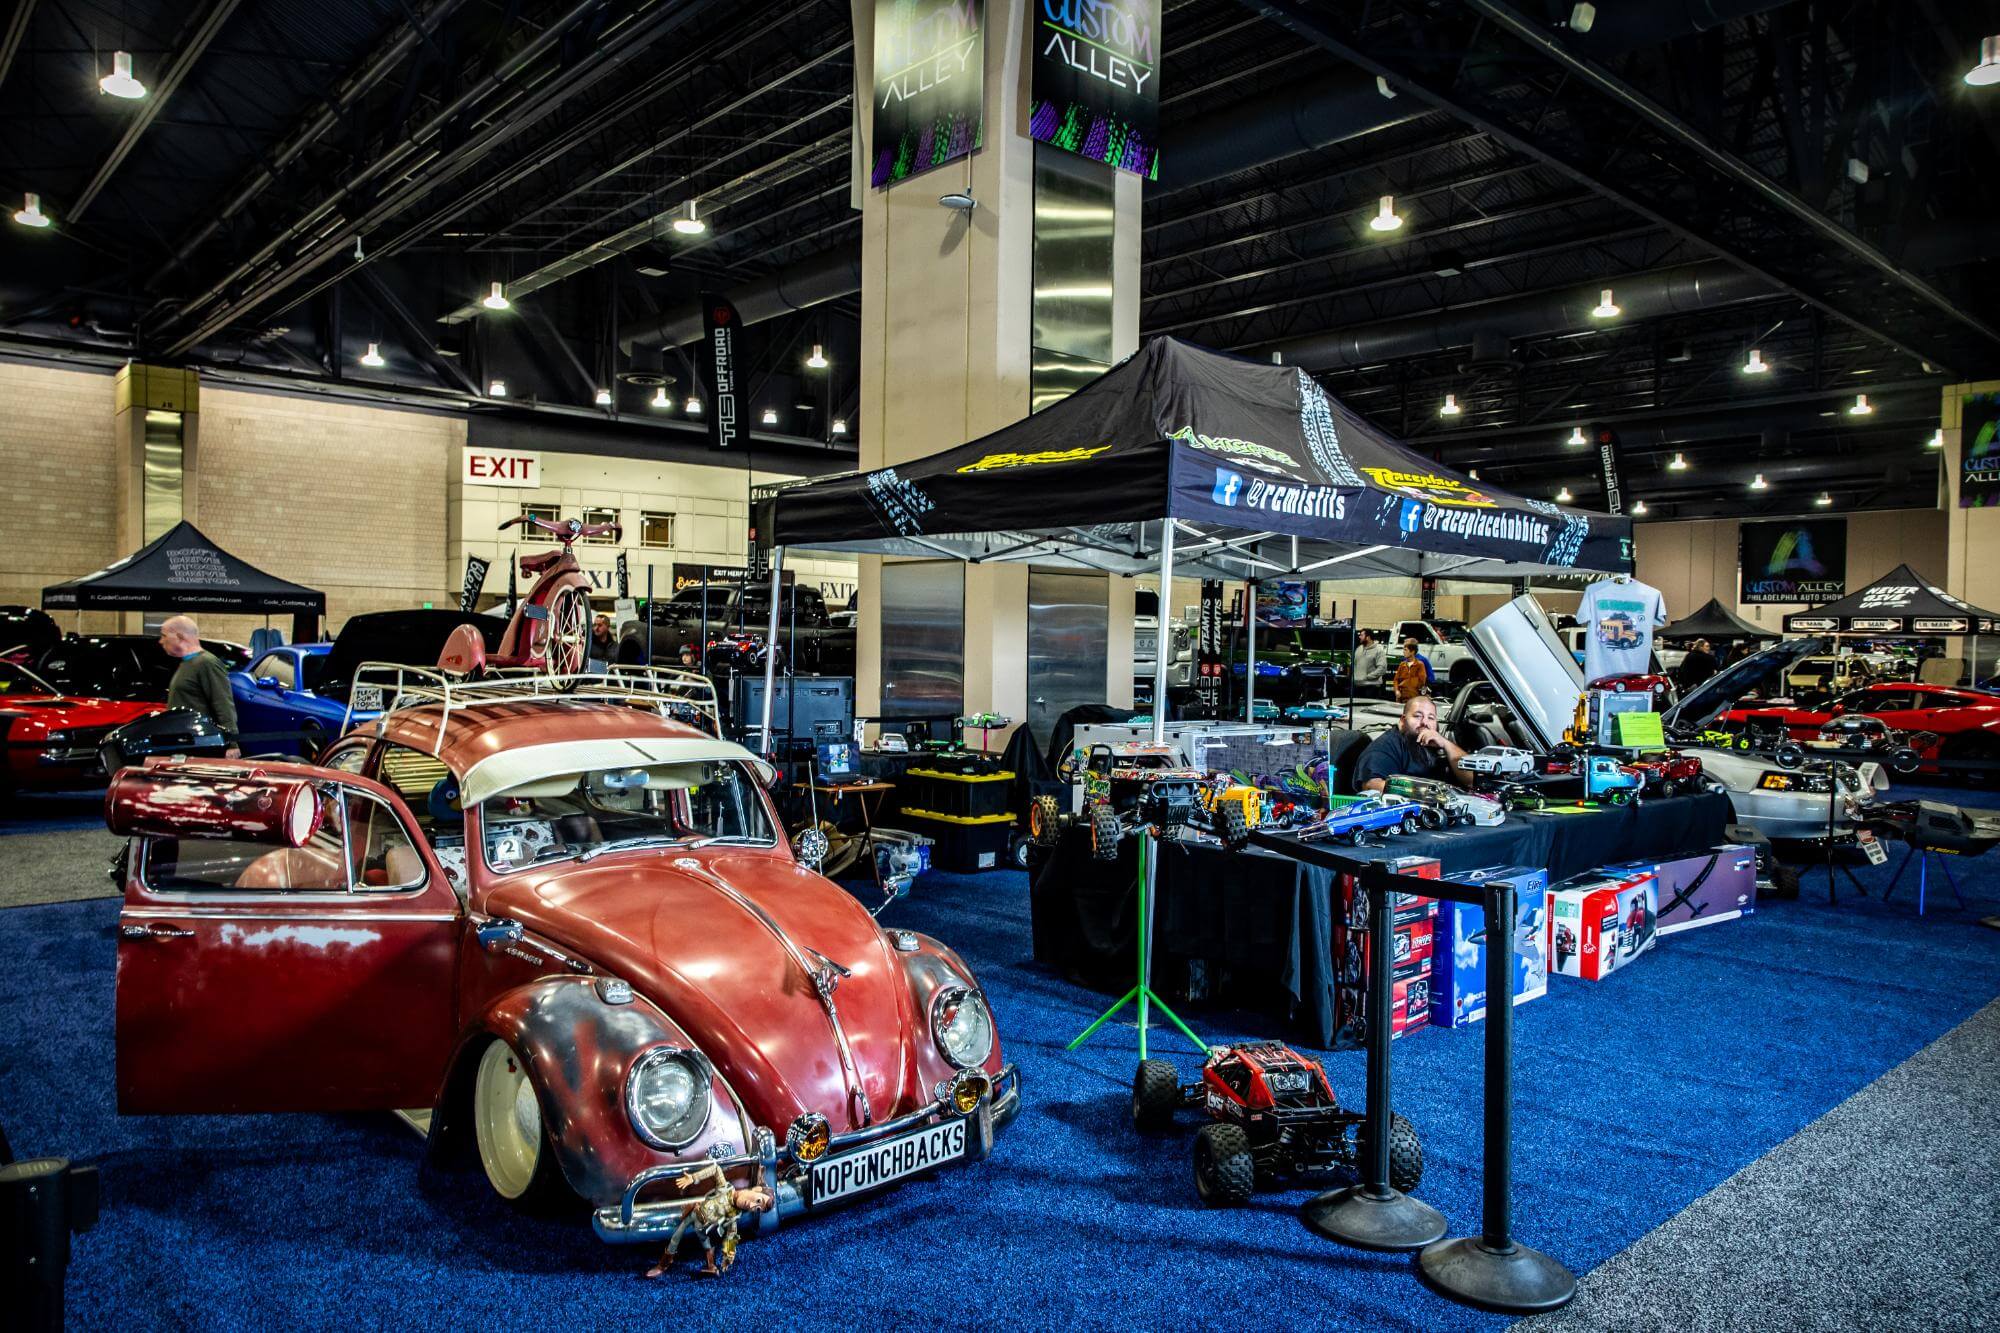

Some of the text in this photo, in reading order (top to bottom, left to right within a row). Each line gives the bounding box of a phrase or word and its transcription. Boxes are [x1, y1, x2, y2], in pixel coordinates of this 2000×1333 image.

[882, 40, 975, 109] ALLEY
[1044, 32, 1151, 95] ALLEY
[714, 328, 729, 393] OFFROAD
[470, 455, 534, 479] EXIT
[1601, 445, 1615, 489] OFFROAD
[1965, 473, 2000, 483] ALL
[1247, 478, 1345, 520] @rcmisfits
[1423, 503, 1550, 545] @raceplacehobbies
[820, 582, 855, 599] EXIT
[1798, 582, 1844, 591] ALLEY
[1202, 598, 1212, 655] #TEAMTIS
[1213, 598, 1222, 655] #TEAMTIS
[502, 840, 515, 853] 2
